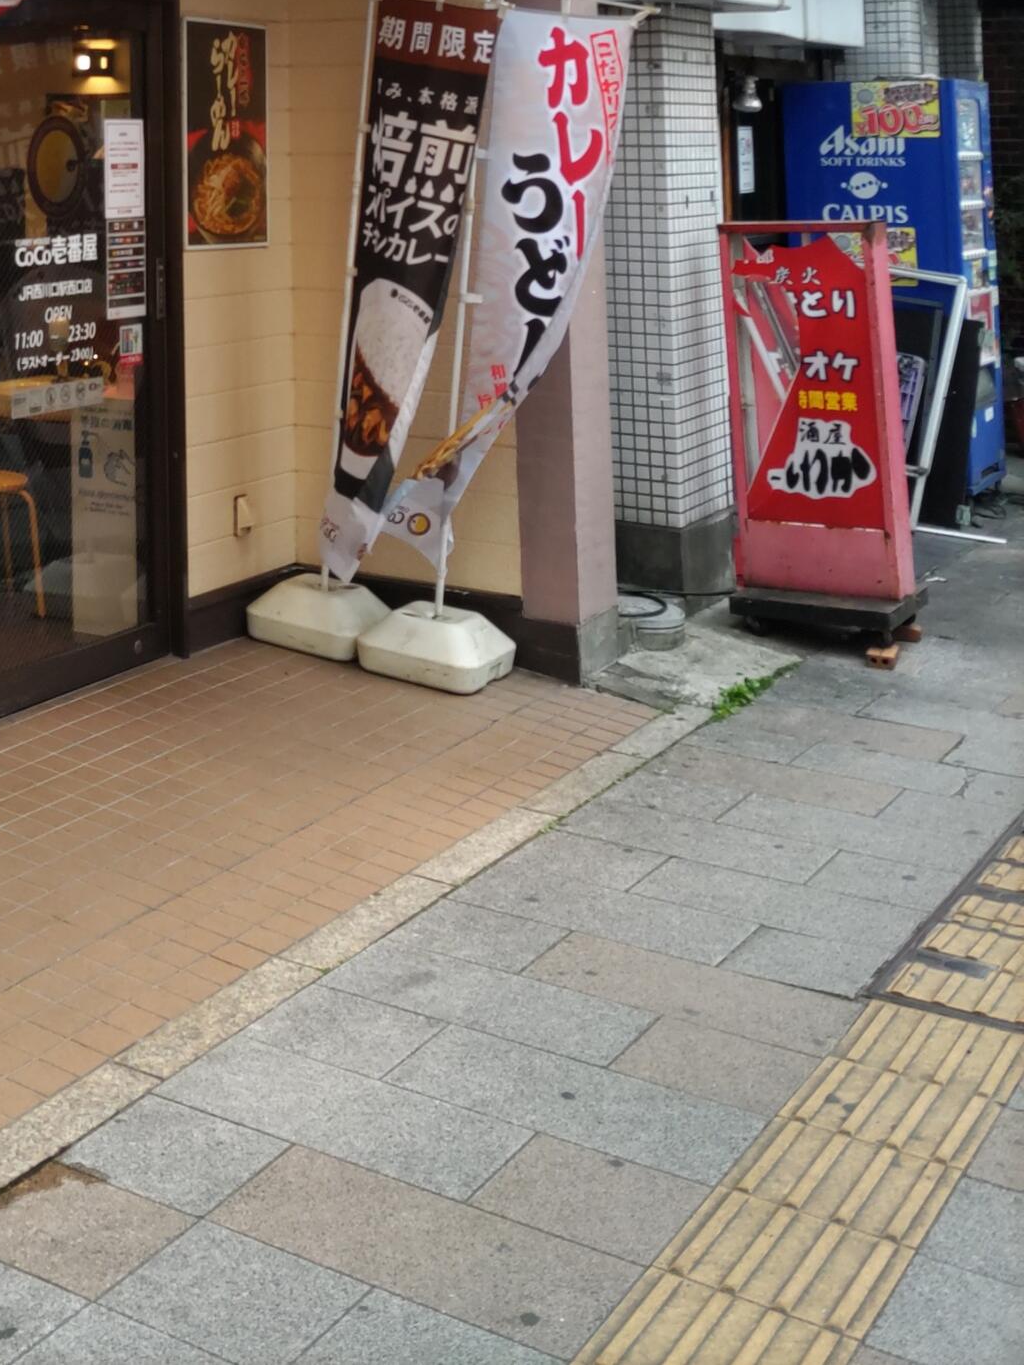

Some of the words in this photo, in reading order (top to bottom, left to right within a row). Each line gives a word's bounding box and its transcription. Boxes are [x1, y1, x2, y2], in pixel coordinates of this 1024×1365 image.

[378, 16, 495, 64] 期間限定
[539, 27, 603, 261] カレー
[820, 157, 853, 167] SOFT
[856, 157, 907, 168] DRINKS
[822, 204, 909, 224] CALPIS
[15, 233, 98, 267] CoCo壱番屋
[45, 305, 73, 324] OPEN
[788, 289, 856, 319] とり
[15, 329, 44, 351] 11:00
[67, 322, 97, 343] 23:30
